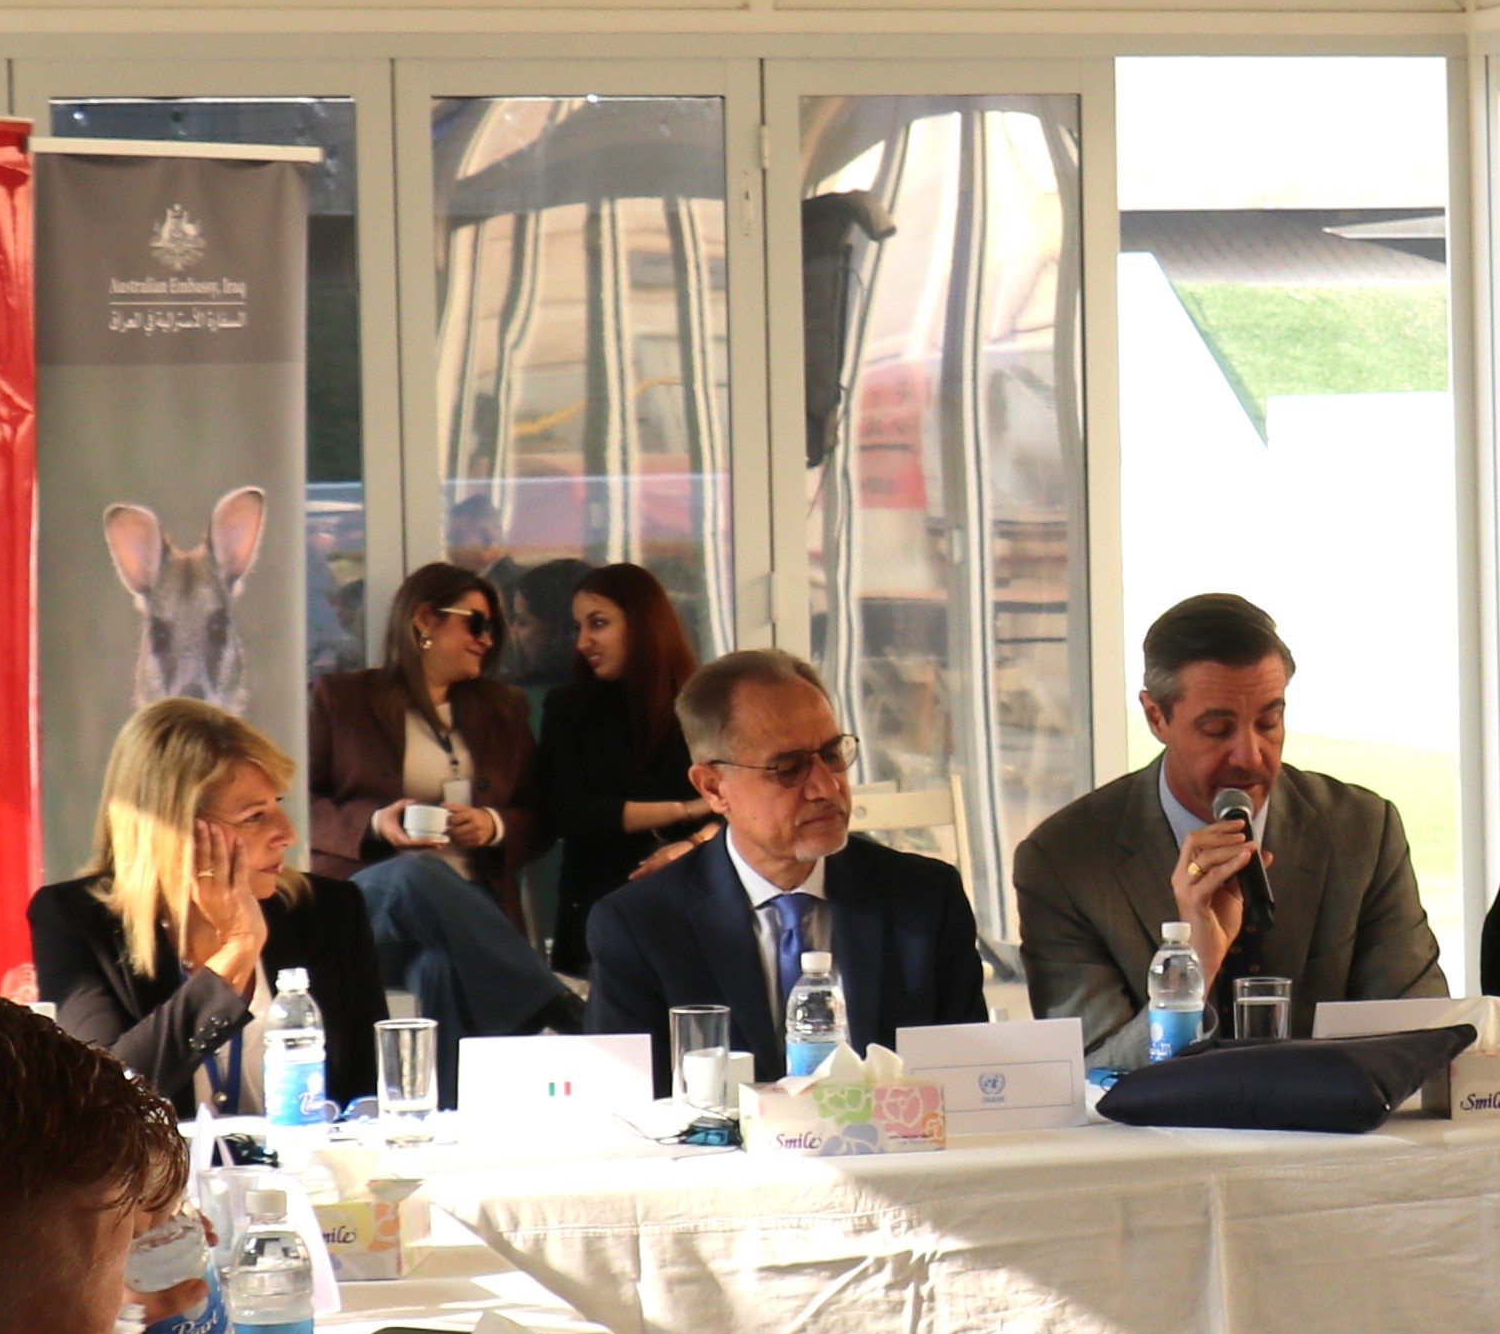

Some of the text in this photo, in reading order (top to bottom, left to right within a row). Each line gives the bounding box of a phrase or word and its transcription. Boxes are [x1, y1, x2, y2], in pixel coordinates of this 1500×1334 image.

[108, 277, 168, 294] Australian
[222, 277, 246, 298] Iraq
[769, 1131, 823, 1150] Smile
[322, 1225, 357, 1244] mile
